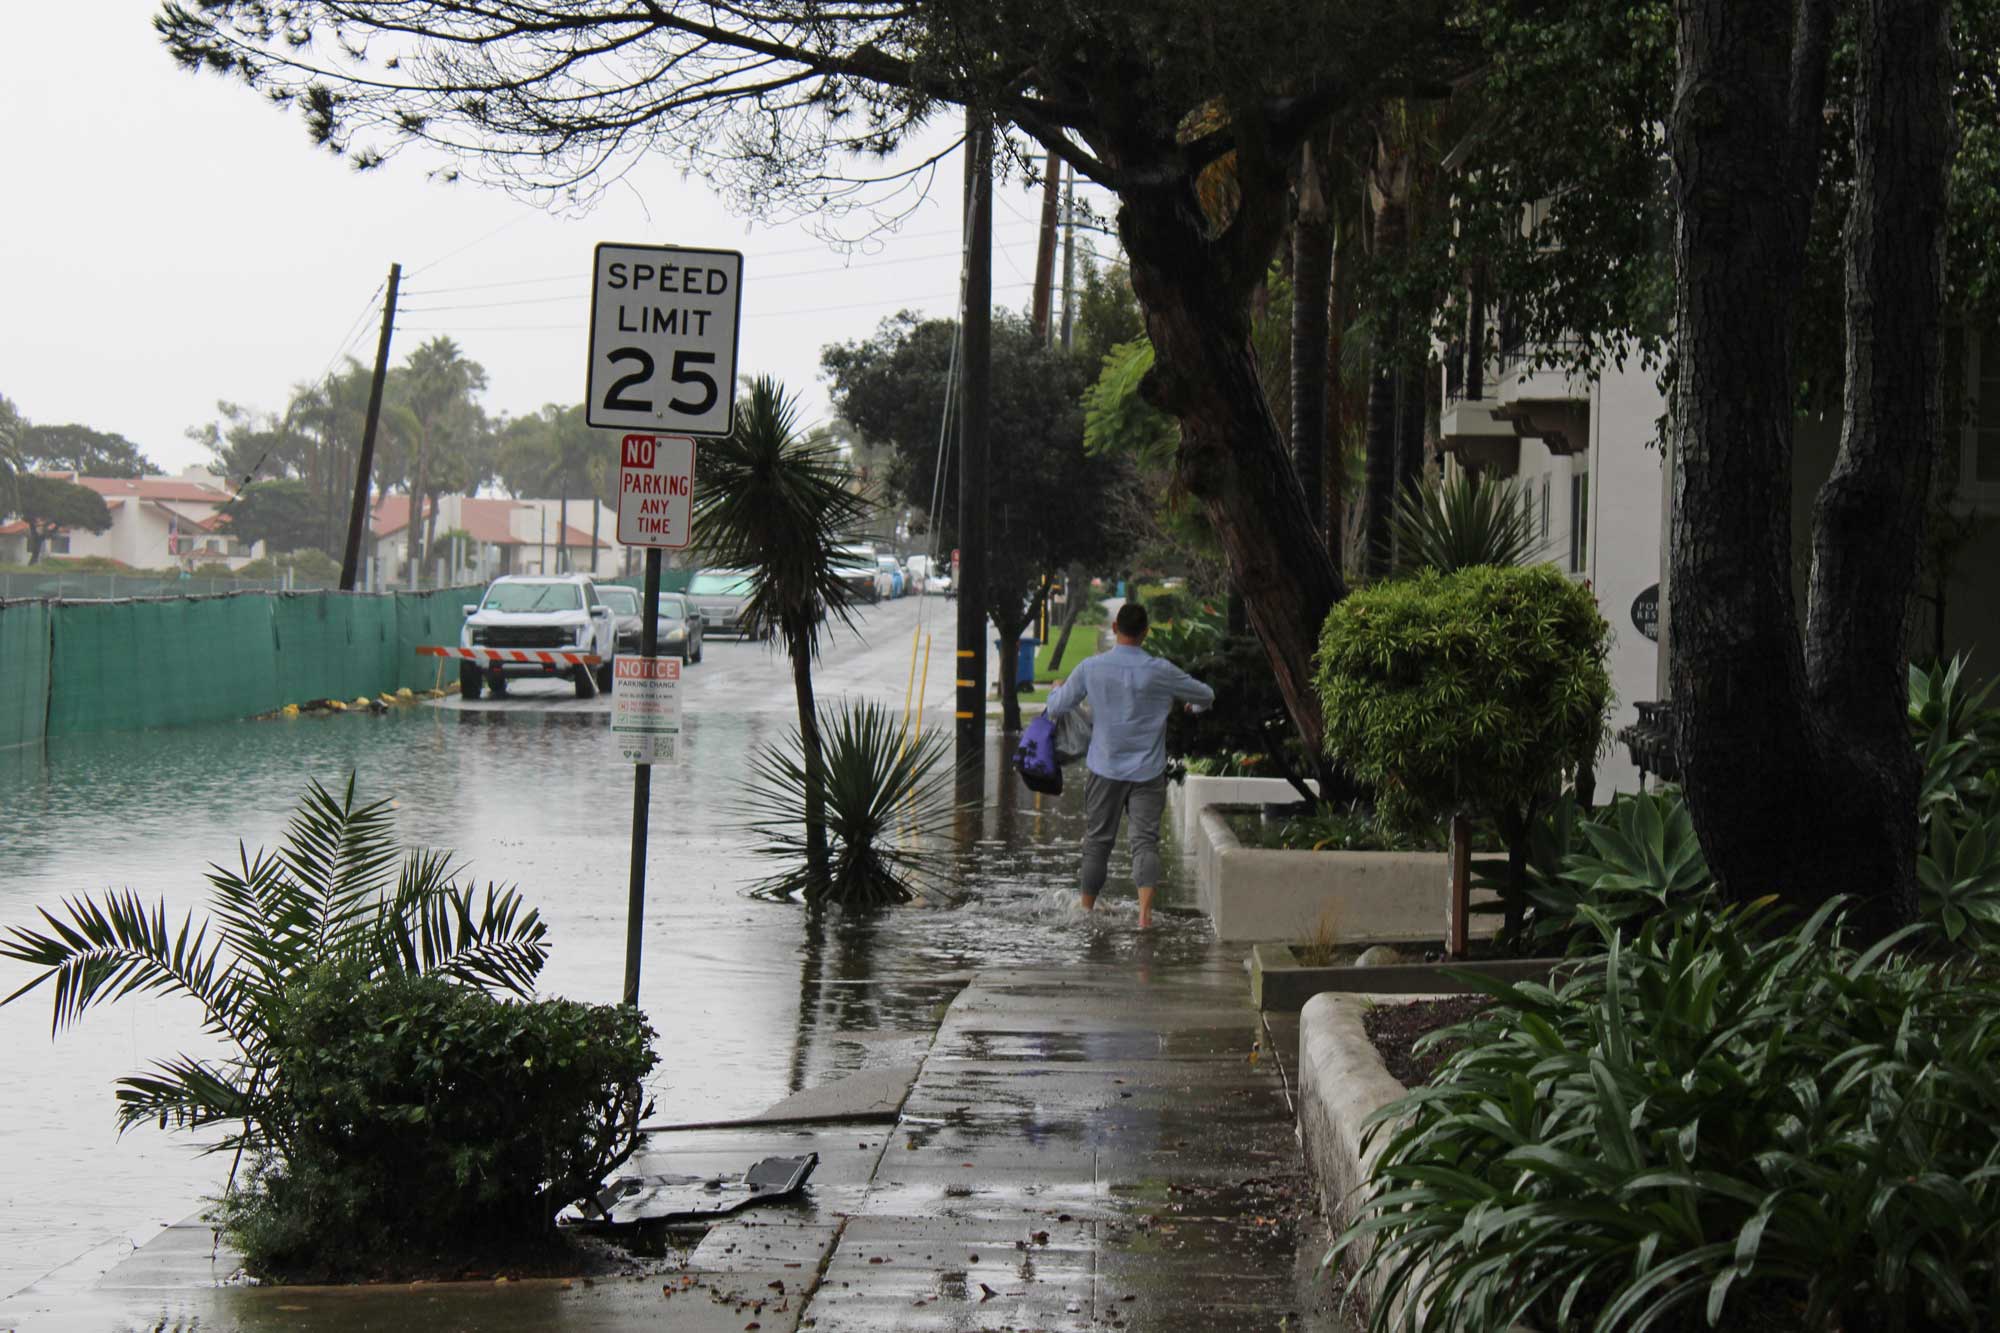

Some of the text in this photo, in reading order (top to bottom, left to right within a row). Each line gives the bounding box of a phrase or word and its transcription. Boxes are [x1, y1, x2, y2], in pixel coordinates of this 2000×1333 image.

[608, 263, 728, 295] SPEED
[618, 305, 712, 336] LIMIT
[603, 347, 718, 415] 25
[627, 440, 652, 464] NO
[624, 473, 688, 496] PARKING
[640, 499, 669, 515] ANY
[638, 517, 670, 534] TIME
[619, 661, 676, 677] NOTICE
[618, 681, 647, 689] PARKING
